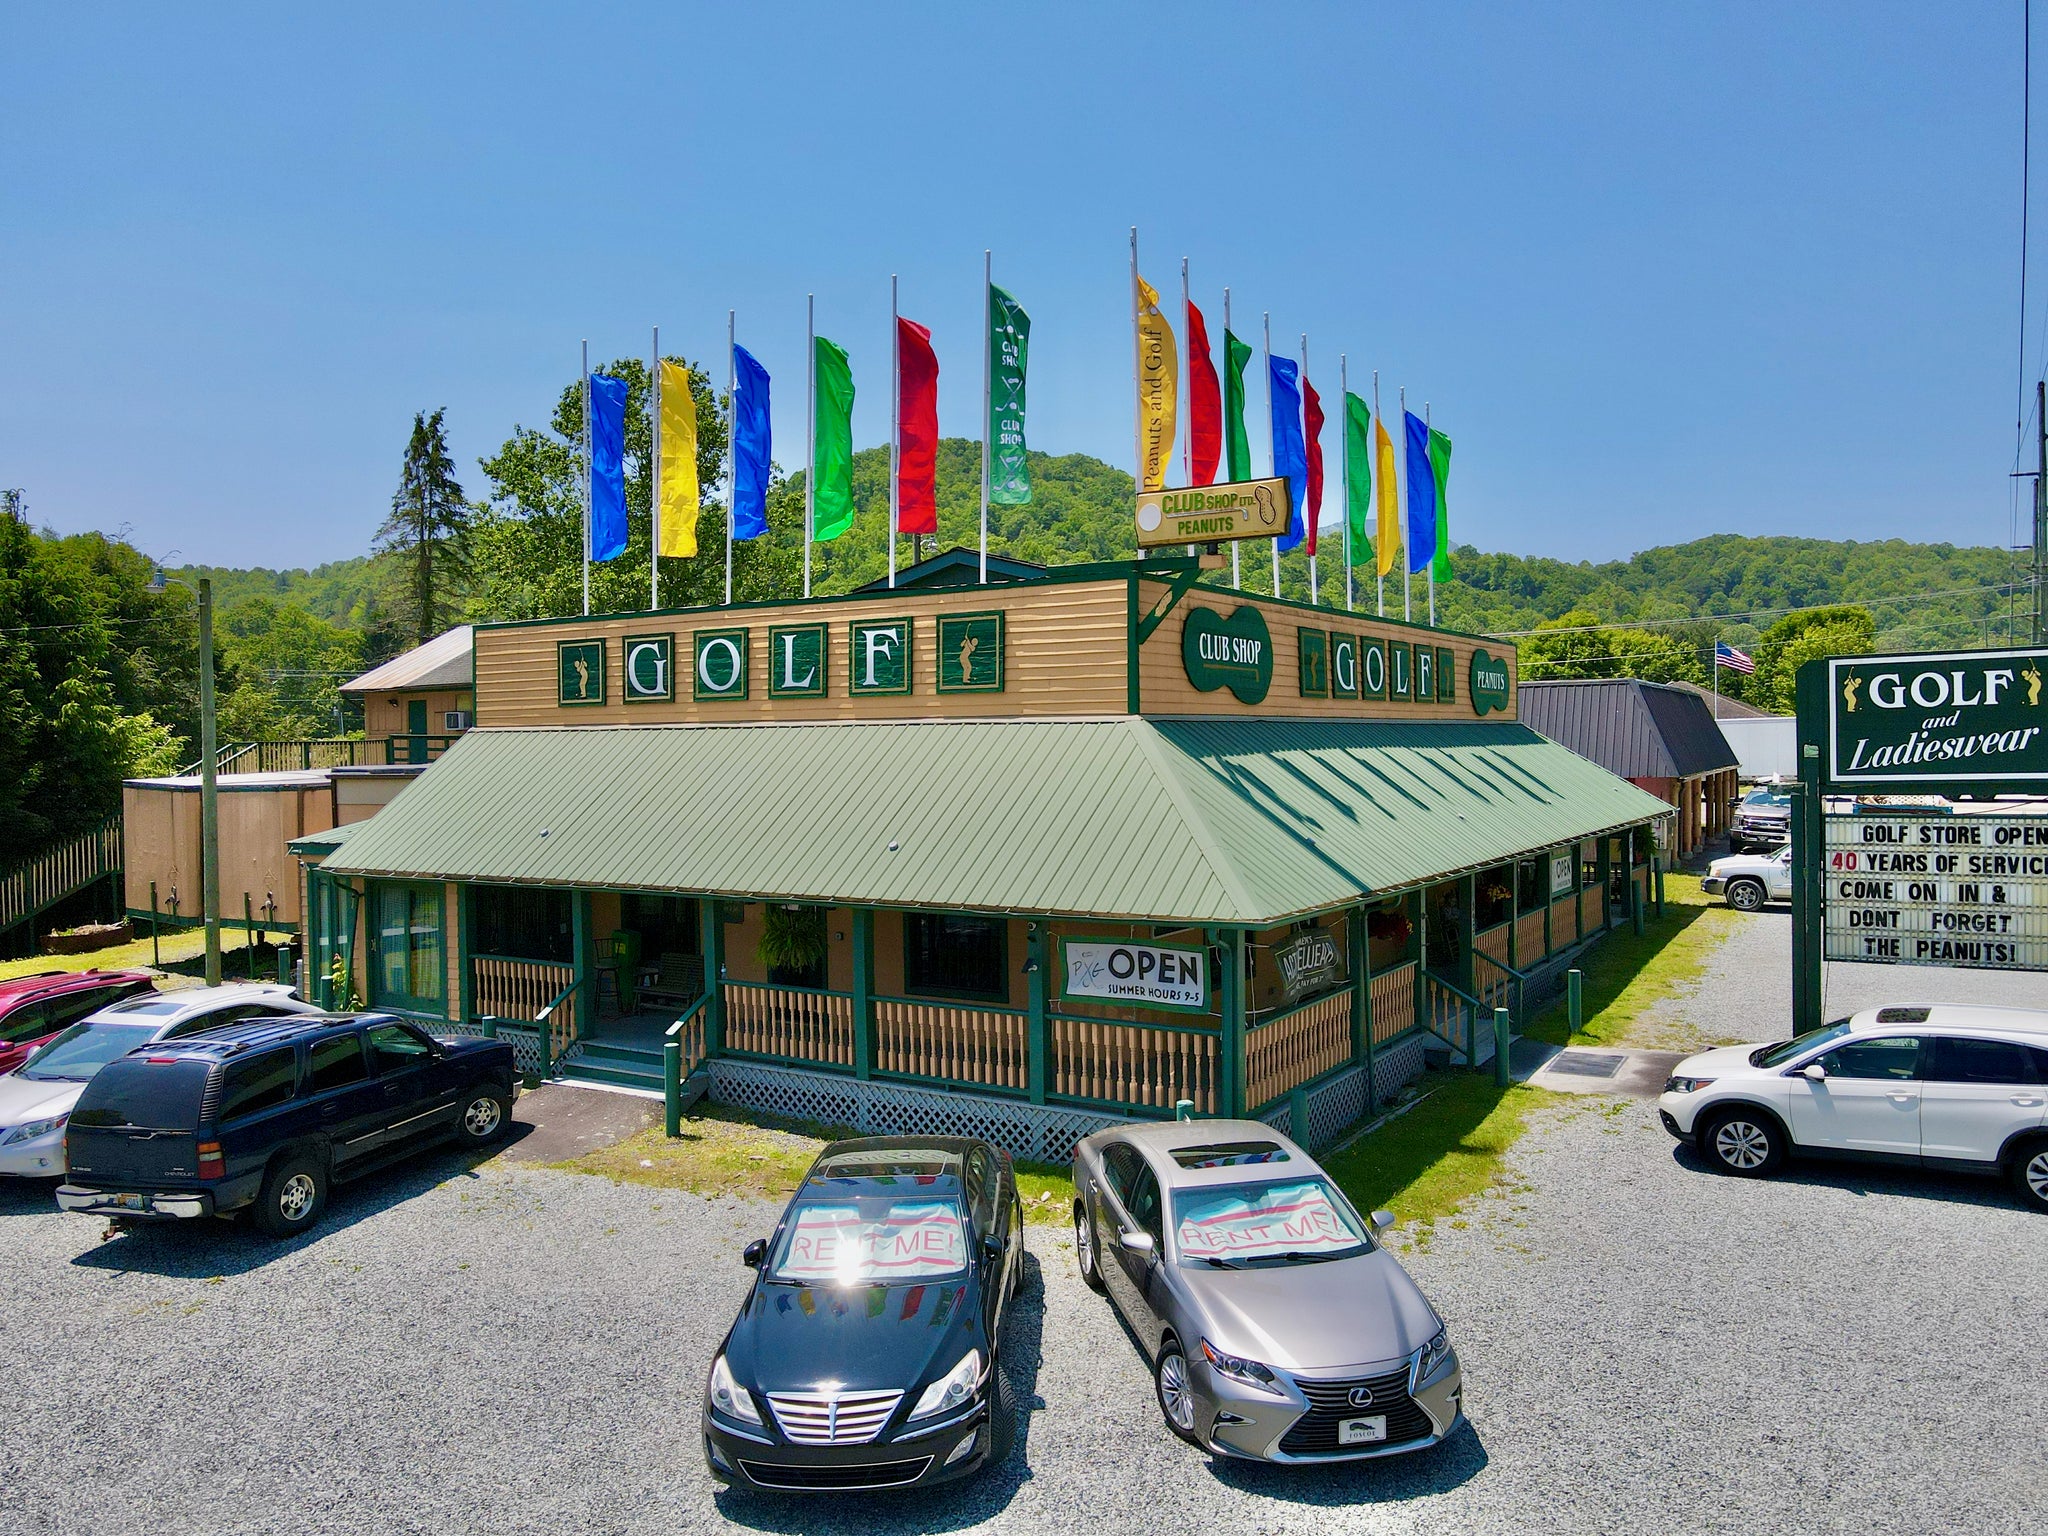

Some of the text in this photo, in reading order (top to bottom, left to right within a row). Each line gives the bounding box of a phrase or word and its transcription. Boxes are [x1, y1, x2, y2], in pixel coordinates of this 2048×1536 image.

[1144, 328, 1162, 490] Peanuts and Golf
[1162, 492, 1207, 514] CLUB
[1207, 493, 1238, 510] SHOP
[1178, 516, 1233, 535] PEANUTS
[1200, 632, 1261, 665] CLUB SHOP
[627, 627, 899, 695] GOLF
[1336, 642, 1431, 695] GOLF
[1477, 671, 1505, 690] PEANUTS
[1869, 669, 2014, 709] GOLF
[1922, 710, 1961, 729] and
[1846, 727, 2040, 771] Ladieswear
[1863, 825, 2048, 845] GOLF STORE OPEN
[1555, 859, 1571, 879] OPEN
[1831, 852, 1857, 870] 40
[1866, 853, 1928, 872] YEARS
[1935, 854, 1959, 873] OF
[1840, 881, 2006, 903] COME ON IN &
[1849, 909, 2012, 932] DONT FORGET
[1864, 937, 2016, 962] THE PEANUTS!
[1108, 948, 1198, 986] OPEN
[1108, 984, 1200, 1002] SUMMER HOURS 9-5
[895, 1230, 954, 1256] ME!
[1181, 1225, 1271, 1247] RENT
